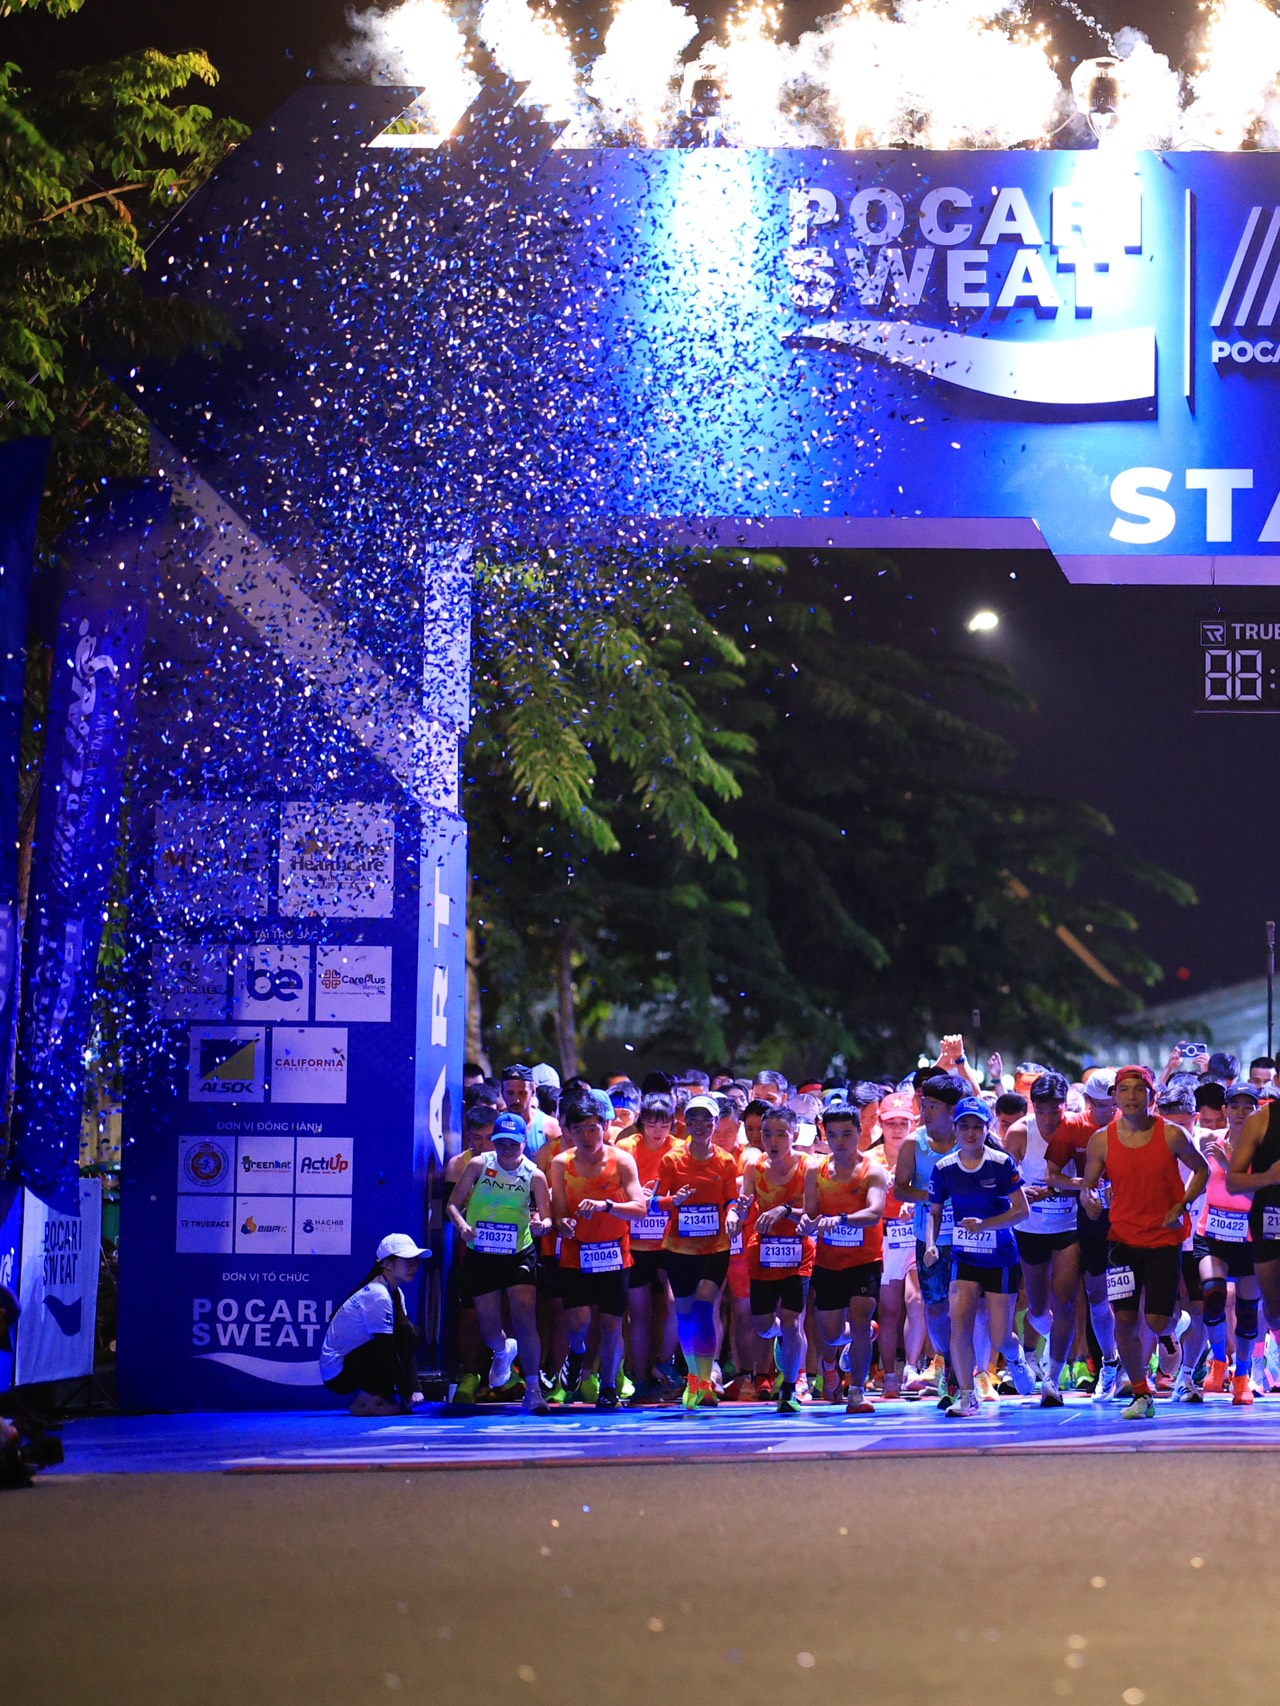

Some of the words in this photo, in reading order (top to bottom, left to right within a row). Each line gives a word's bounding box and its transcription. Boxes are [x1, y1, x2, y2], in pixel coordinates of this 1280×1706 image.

[786, 247, 1114, 308] SWEAT
[247, 957, 303, 1001] be
[341, 974, 386, 984] CarePlus
[275, 1058, 344, 1067] CALIFORNIA
[200, 1082, 254, 1094] ALSOK
[216, 1121, 241, 1131] ĐƠN
[256, 1120, 289, 1131] ĐỒNG
[481, 1178, 525, 1192] ANTA
[191, 1220, 231, 1228] TRUERACE
[634, 1218, 666, 1228] 210019
[683, 1215, 715, 1226] 213411
[1210, 1217, 1244, 1231] 210422
[43, 1221, 82, 1252] POCARI
[478, 1231, 512, 1242] 210373
[834, 1226, 858, 1236] 4627
[891, 1227, 913, 1237] 2134
[583, 1250, 618, 1262] 210049
[765, 1246, 796, 1257] 213131
[222, 1271, 247, 1282] ĐƠN
[1107, 1275, 1130, 1289] 3540
[192, 1298, 333, 1323] POCARI
[191, 1323, 321, 1348] SWEAT
